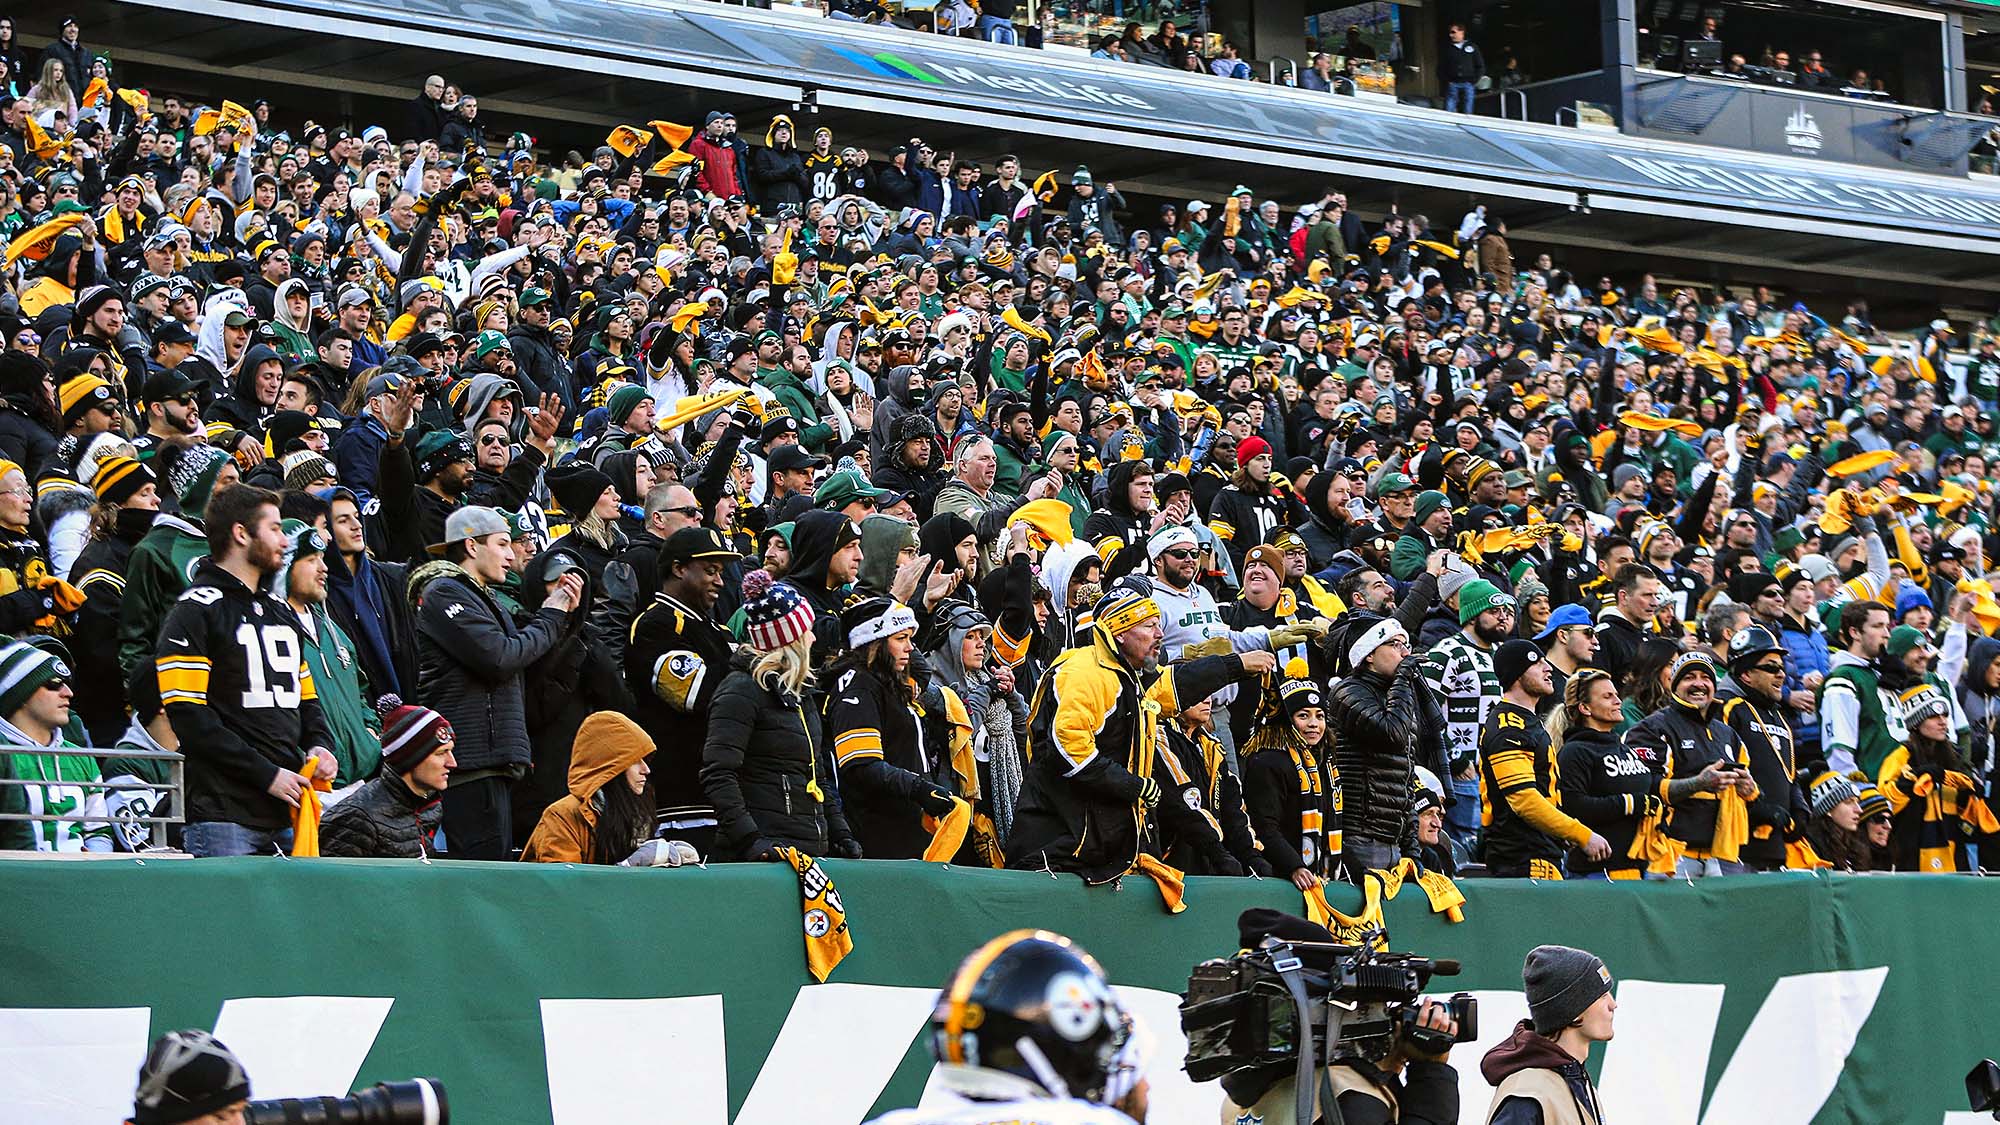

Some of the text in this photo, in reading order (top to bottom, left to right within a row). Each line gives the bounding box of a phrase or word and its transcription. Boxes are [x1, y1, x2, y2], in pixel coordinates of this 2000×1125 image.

[924, 62, 1156, 110] MetLife
[813, 172, 837, 199] 86
[1608, 154, 2000, 224] METLIFE STADIU
[1179, 611, 1222, 627] JETS
[236, 623, 302, 709] 19
